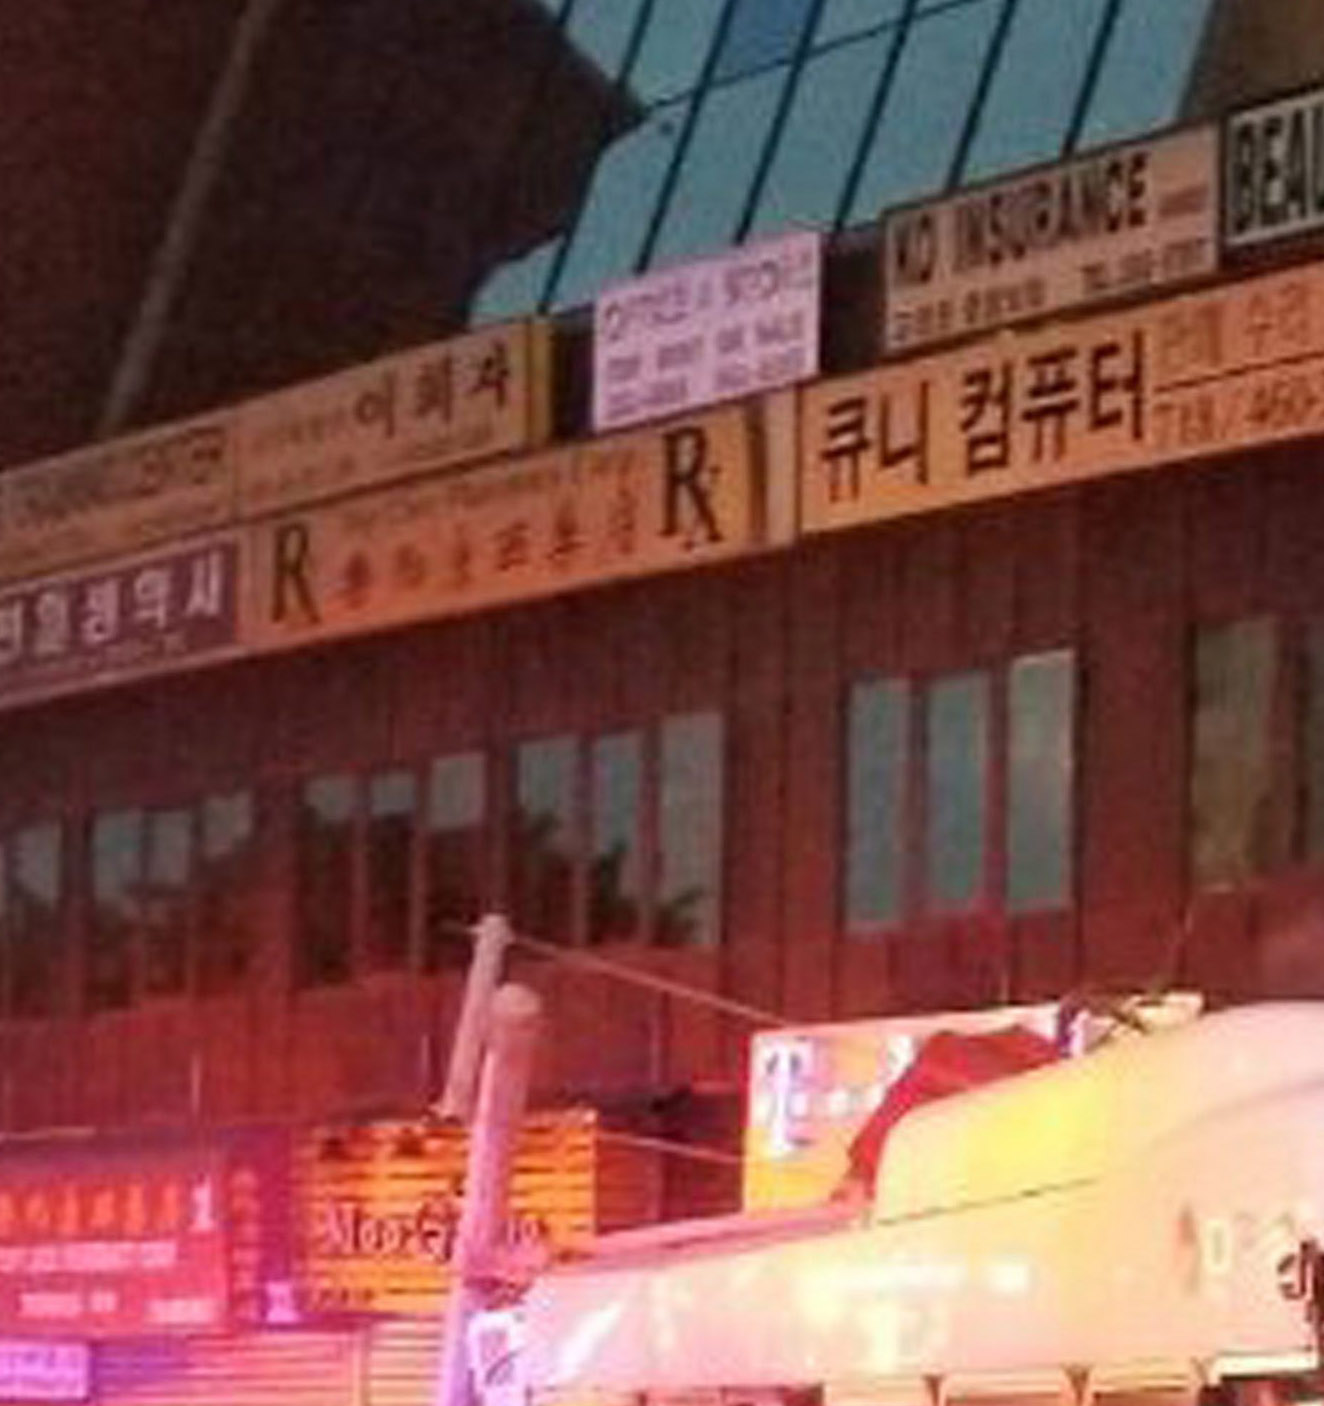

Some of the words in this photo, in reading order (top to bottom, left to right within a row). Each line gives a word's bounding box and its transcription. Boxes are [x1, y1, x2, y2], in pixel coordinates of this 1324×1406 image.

[952, 150, 1148, 275] INSURANCE
[820, 380, 931, 503] 큐니
[960, 328, 1144, 478] 컴퓨터
